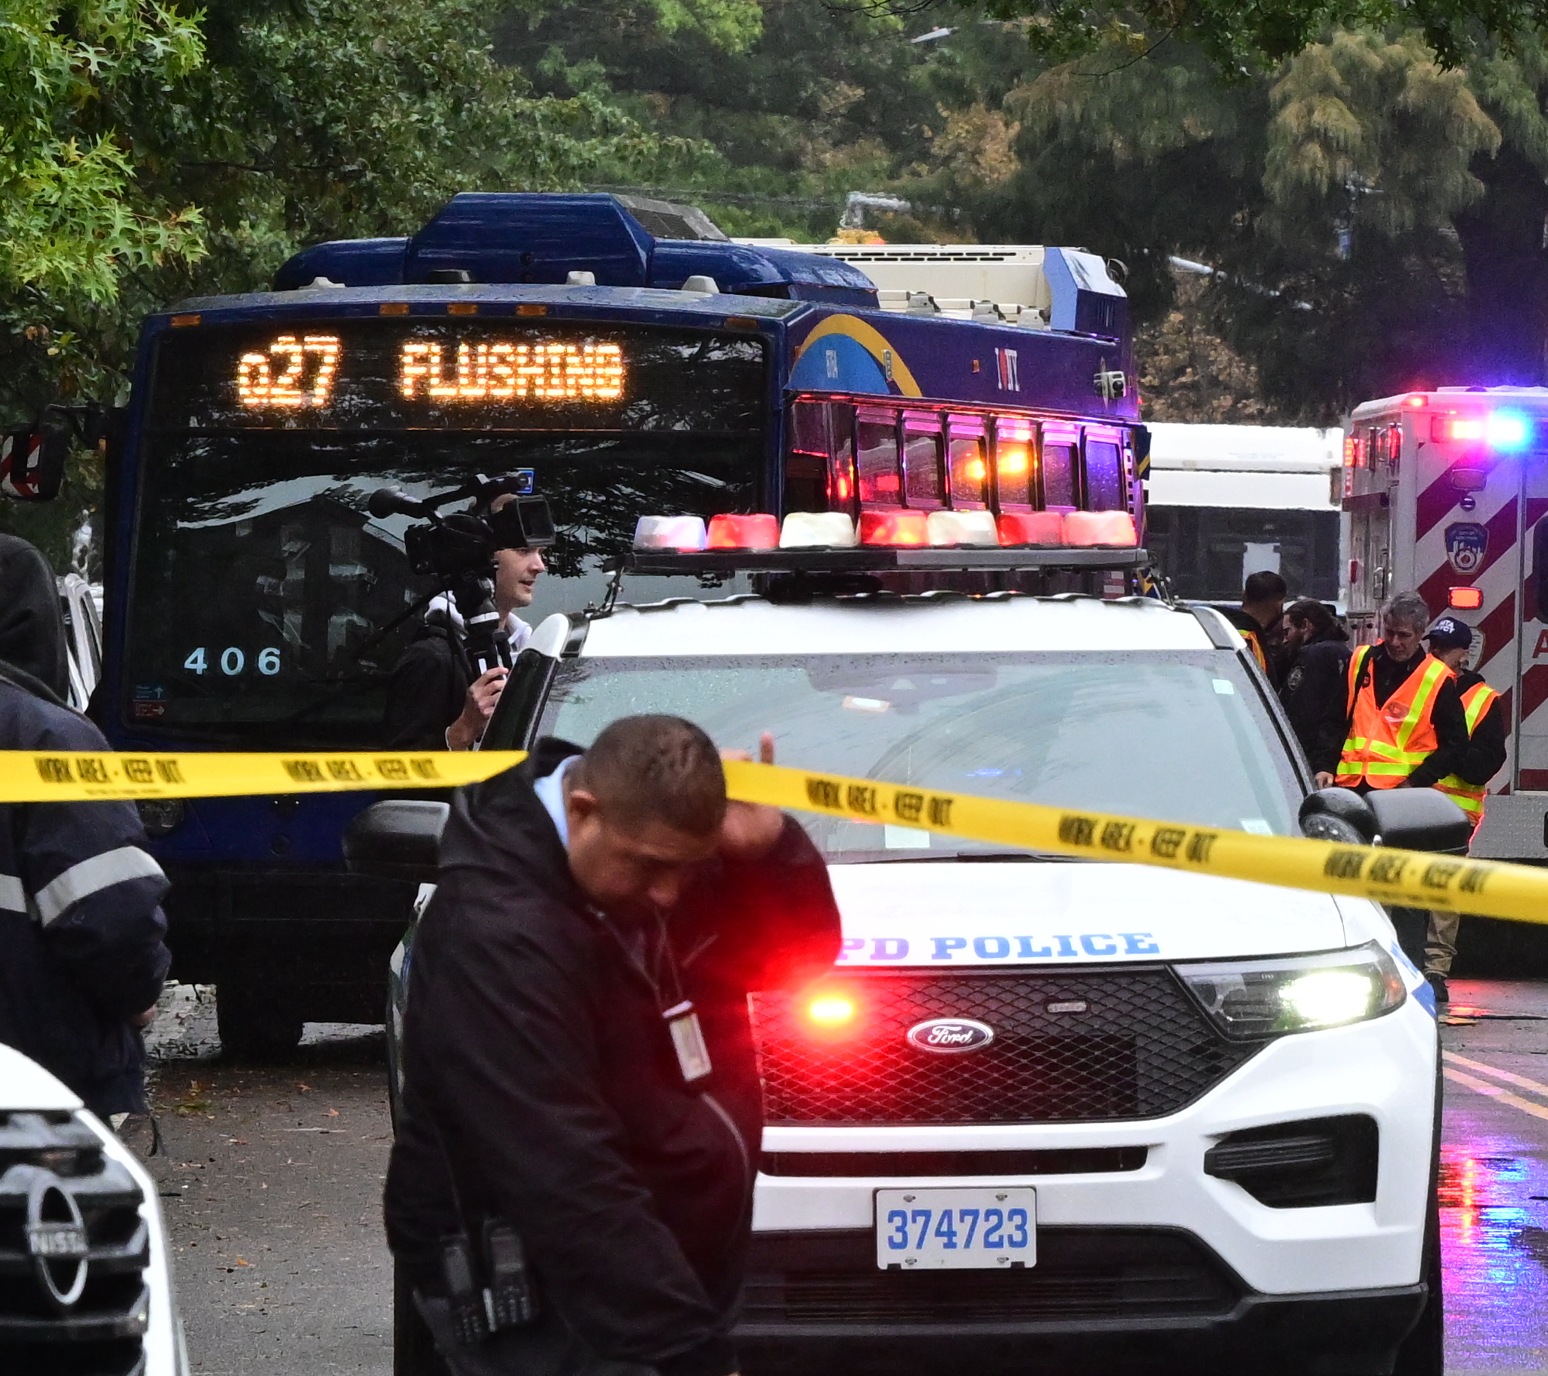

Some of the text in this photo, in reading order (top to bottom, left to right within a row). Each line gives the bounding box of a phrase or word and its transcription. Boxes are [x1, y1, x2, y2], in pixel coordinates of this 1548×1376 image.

[402, 342, 625, 399] FLUSHING
[183, 647, 281, 675] 406
[35, 757, 187, 784] WORK AREA KEEP OUT
[893, 791, 925, 822] KEEP
[1151, 827, 1187, 859] KEEP
[838, 932, 1161, 961] PD POLICE
[927, 1025, 974, 1044] Ford
[886, 1207, 1029, 1251] 374723
